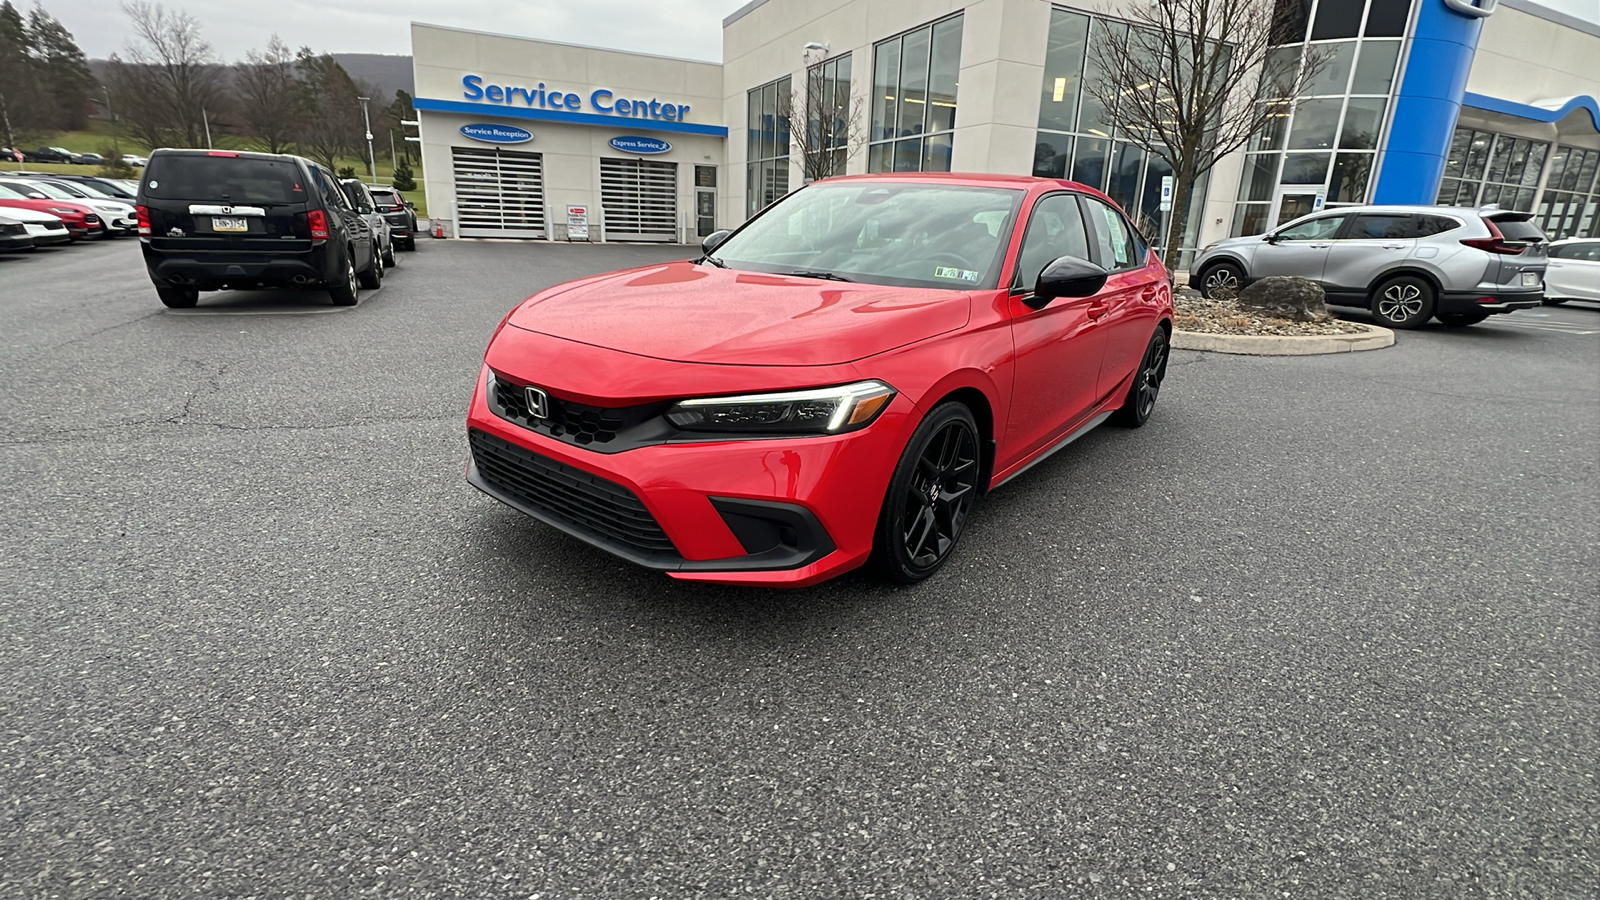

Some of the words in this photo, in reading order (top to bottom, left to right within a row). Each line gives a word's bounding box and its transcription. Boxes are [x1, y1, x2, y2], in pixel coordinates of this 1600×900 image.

[462, 74, 581, 110] Service
[590, 89, 690, 121] Center
[464, 126, 492, 135] Service
[493, 128, 529, 138] Reception
[612, 139, 636, 147] Express
